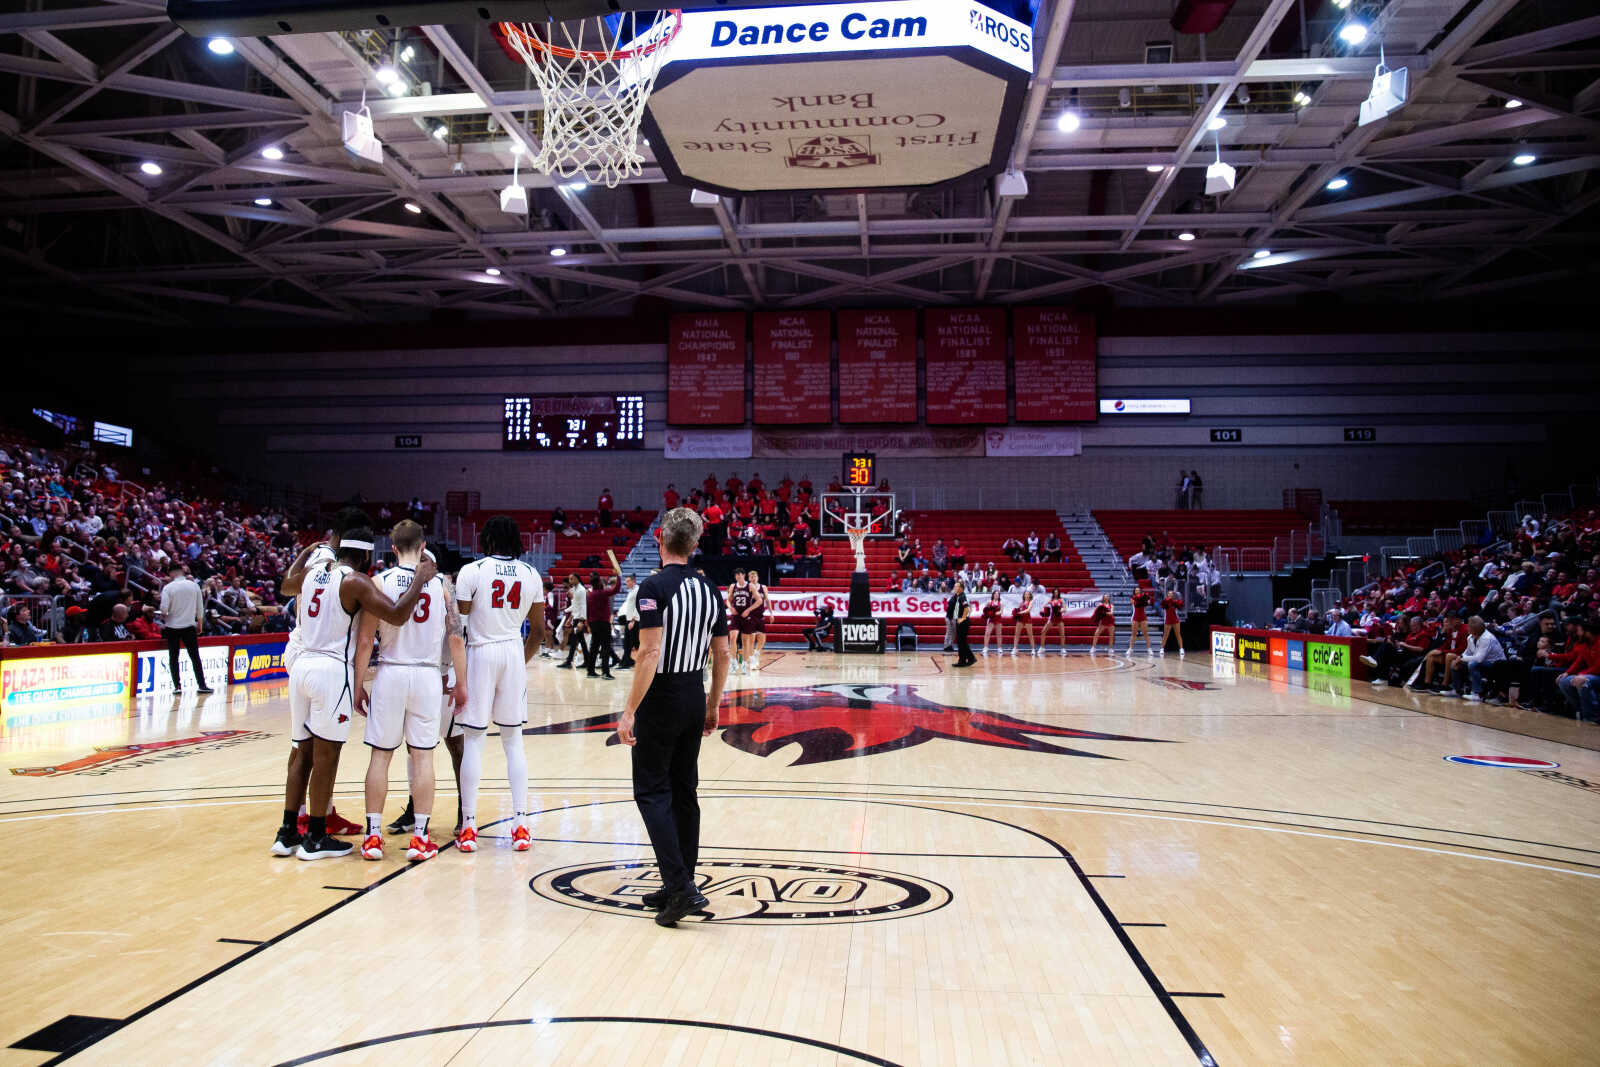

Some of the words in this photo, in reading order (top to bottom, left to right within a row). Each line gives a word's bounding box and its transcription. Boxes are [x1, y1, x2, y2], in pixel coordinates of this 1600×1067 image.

[711, 20, 829, 48] Dance
[840, 13, 928, 40] Cam
[985, 15, 1031, 53] ROSS
[773, 91, 876, 109] Bank
[714, 112, 947, 134] Community
[683, 139, 774, 155] State
[895, 130, 980, 148] First
[682, 329, 732, 340] NATIONAL
[1214, 430, 1237, 440] 101
[850, 467, 870, 485] 30
[495, 563, 518, 577] CLARK
[307, 588, 325, 618] 5
[491, 579, 521, 610] 24
[735, 596, 747, 607] 23
[764, 595, 809, 613] rowd
[841, 624, 879, 641] FLYCGI
[234, 657, 247, 672] NAPA
[250, 655, 271, 671] AUTO
[1313, 646, 1343, 667] cricket
[2, 667, 46, 700] PLAZA
